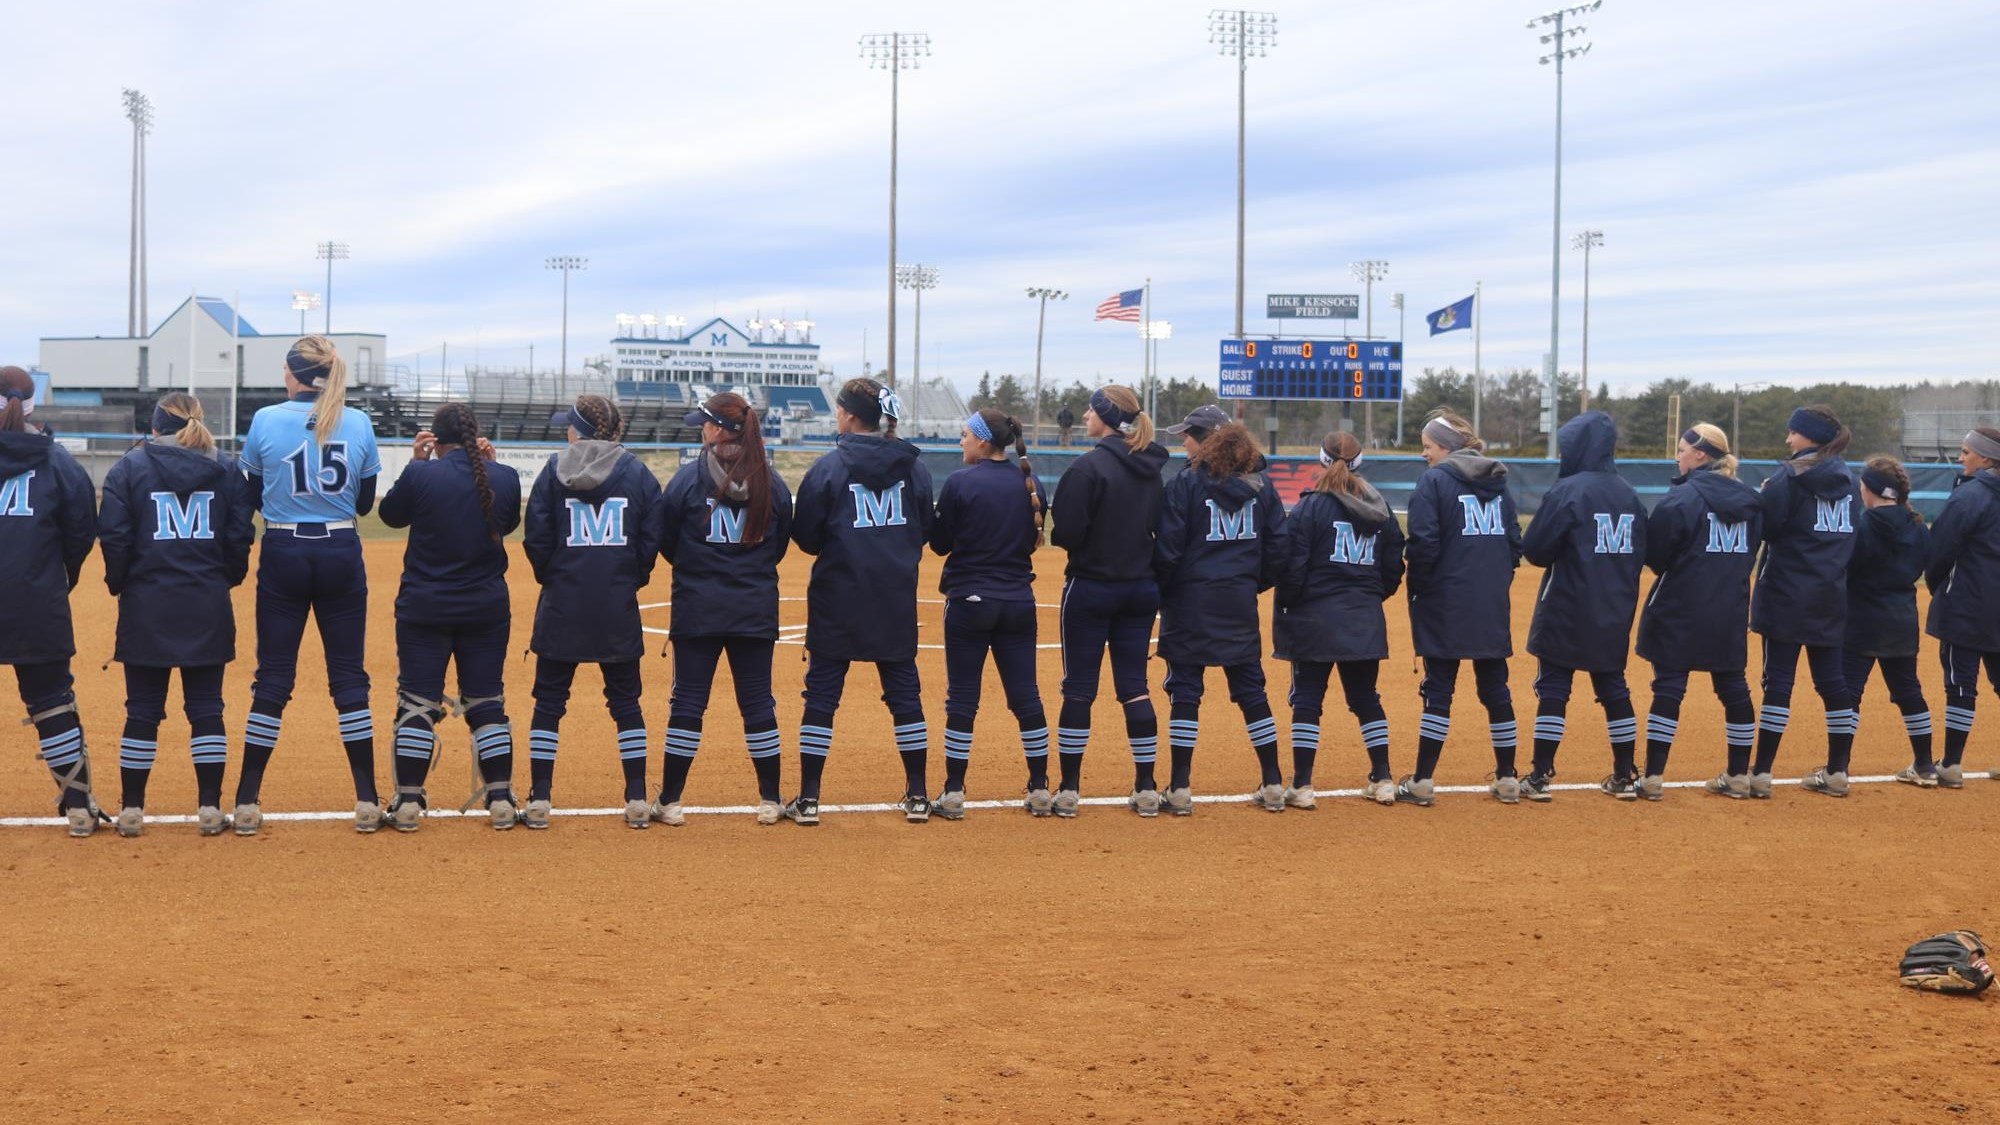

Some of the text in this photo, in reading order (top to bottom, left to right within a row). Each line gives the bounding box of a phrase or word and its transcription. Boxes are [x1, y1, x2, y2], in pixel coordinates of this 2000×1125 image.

[1269, 296, 1358, 307] MIKE KESSOCK
[1295, 307, 1331, 317] FIELD
[711, 333, 728, 346] M
[1222, 341, 1257, 358] BALL 0
[1271, 342, 1313, 359] STRIKE 0
[1329, 342, 1358, 360] OUT 0
[1373, 346, 1390, 357] H/E
[620, 358, 663, 366] HAROLD
[720, 361, 762, 369] SPORTS
[1221, 369, 1363, 383] GUEST 0
[1344, 361, 1363, 371] RUNS
[1368, 361, 1385, 371] HITS
[1221, 384, 1363, 398] HOME 0
[281, 440, 350, 497] 15
[0, 470, 35, 516] M
[848, 480, 907, 528] M
[151, 491, 214, 540] M
[565, 497, 628, 547] M
[1205, 498, 1257, 541] M
[1457, 494, 1505, 536] M
[1813, 494, 1854, 533] M
[1329, 521, 1377, 565] M
[1593, 513, 1635, 553] M
[1705, 512, 1748, 553] M
